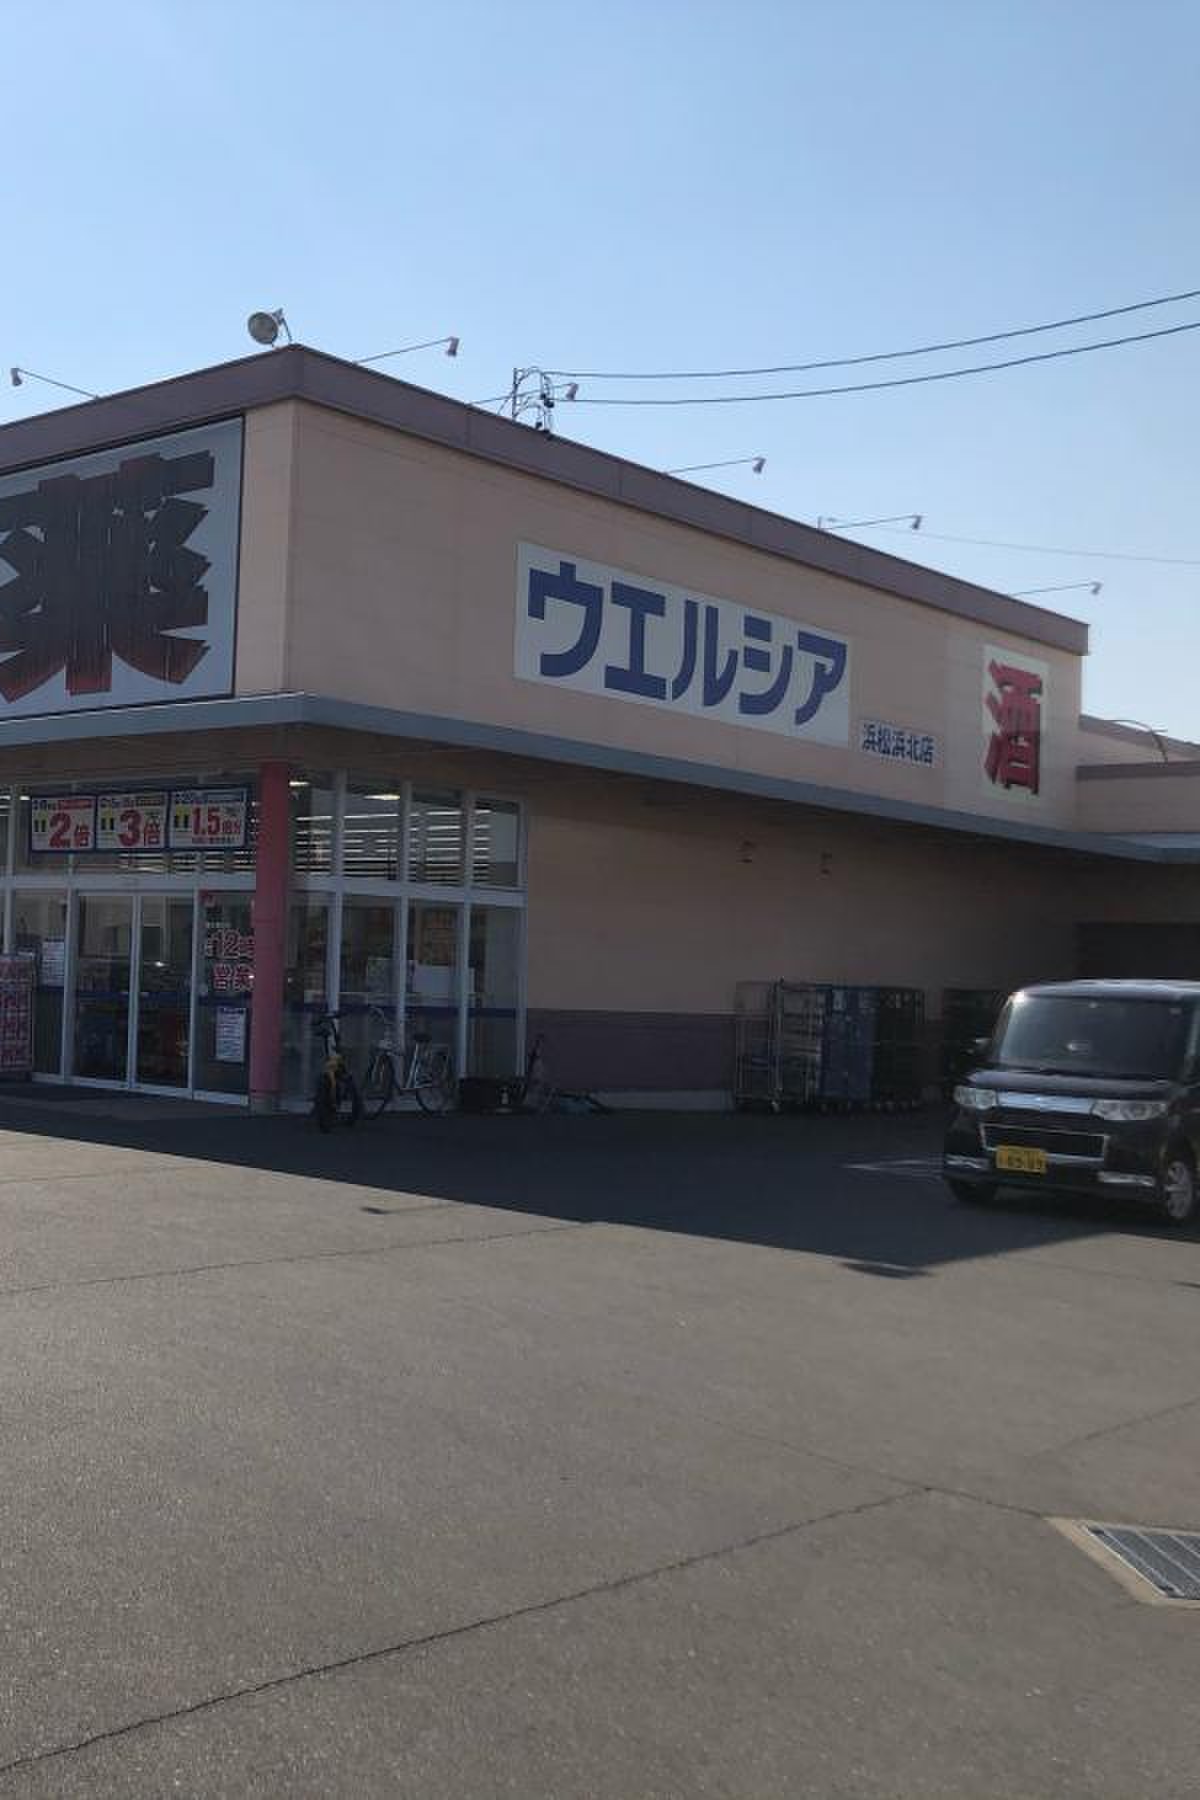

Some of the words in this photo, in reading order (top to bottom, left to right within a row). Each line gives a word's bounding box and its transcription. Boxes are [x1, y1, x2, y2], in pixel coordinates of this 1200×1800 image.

[527, 560, 848, 726] ウエルシア
[862, 723, 935, 764] 浜松浜北店
[985, 659, 1042, 795] 酒
